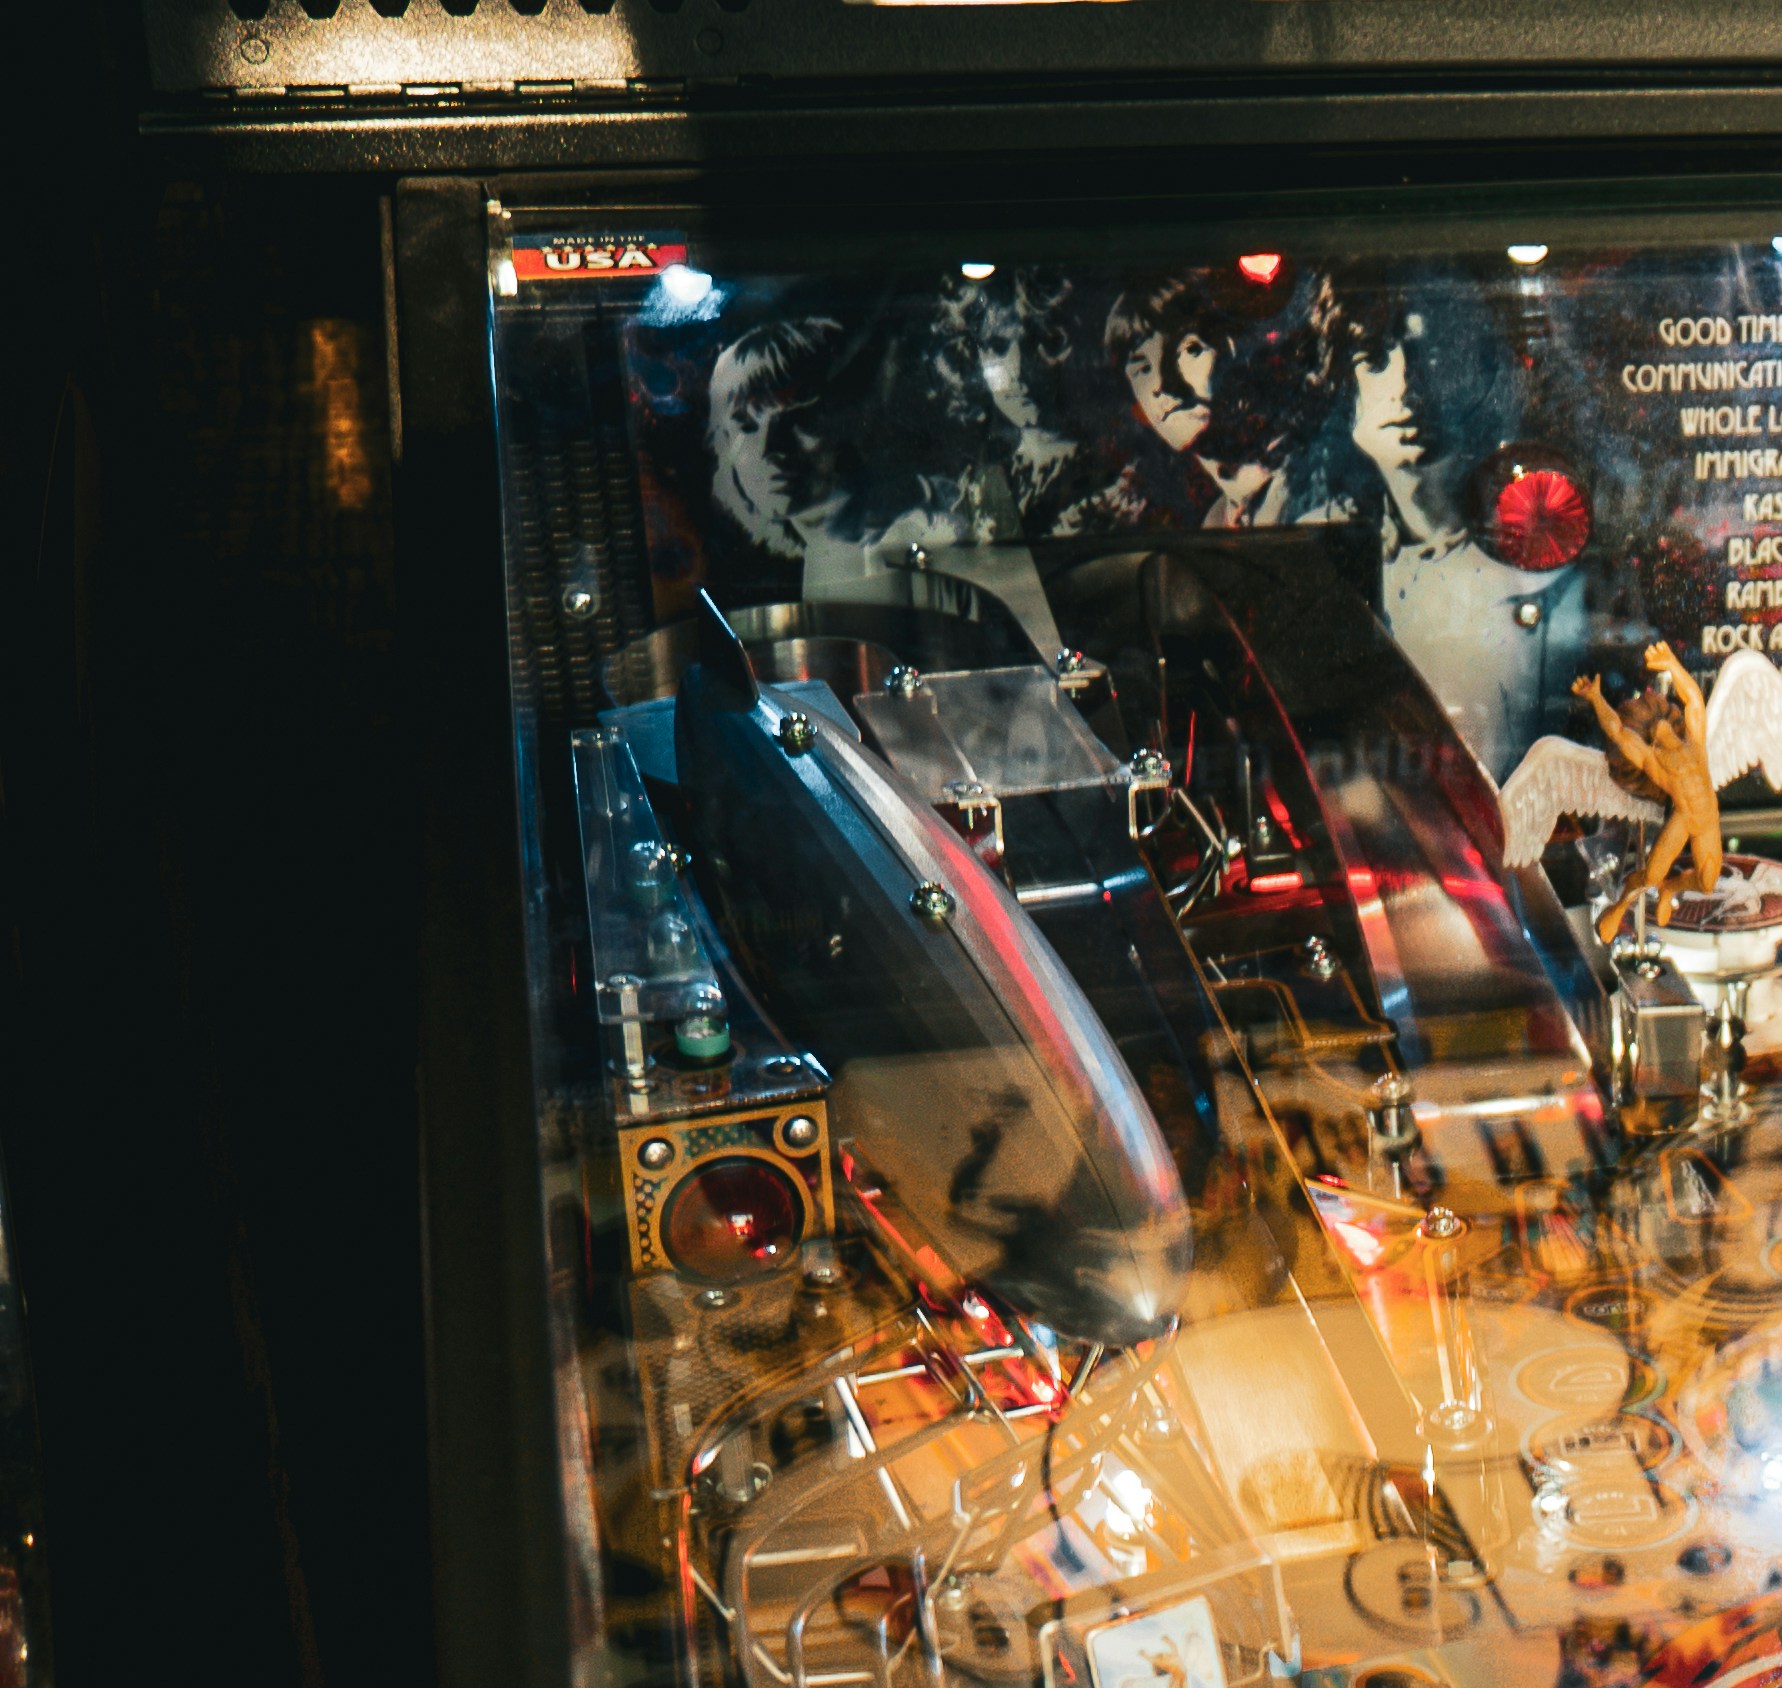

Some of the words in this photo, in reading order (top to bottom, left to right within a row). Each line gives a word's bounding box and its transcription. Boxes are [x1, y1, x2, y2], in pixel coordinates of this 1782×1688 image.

[546, 250, 655, 271] USA
[1659, 316, 1732, 347] GOOD
[1681, 404, 1763, 437] WHOLE
[1703, 623, 1763, 654] ROCK
